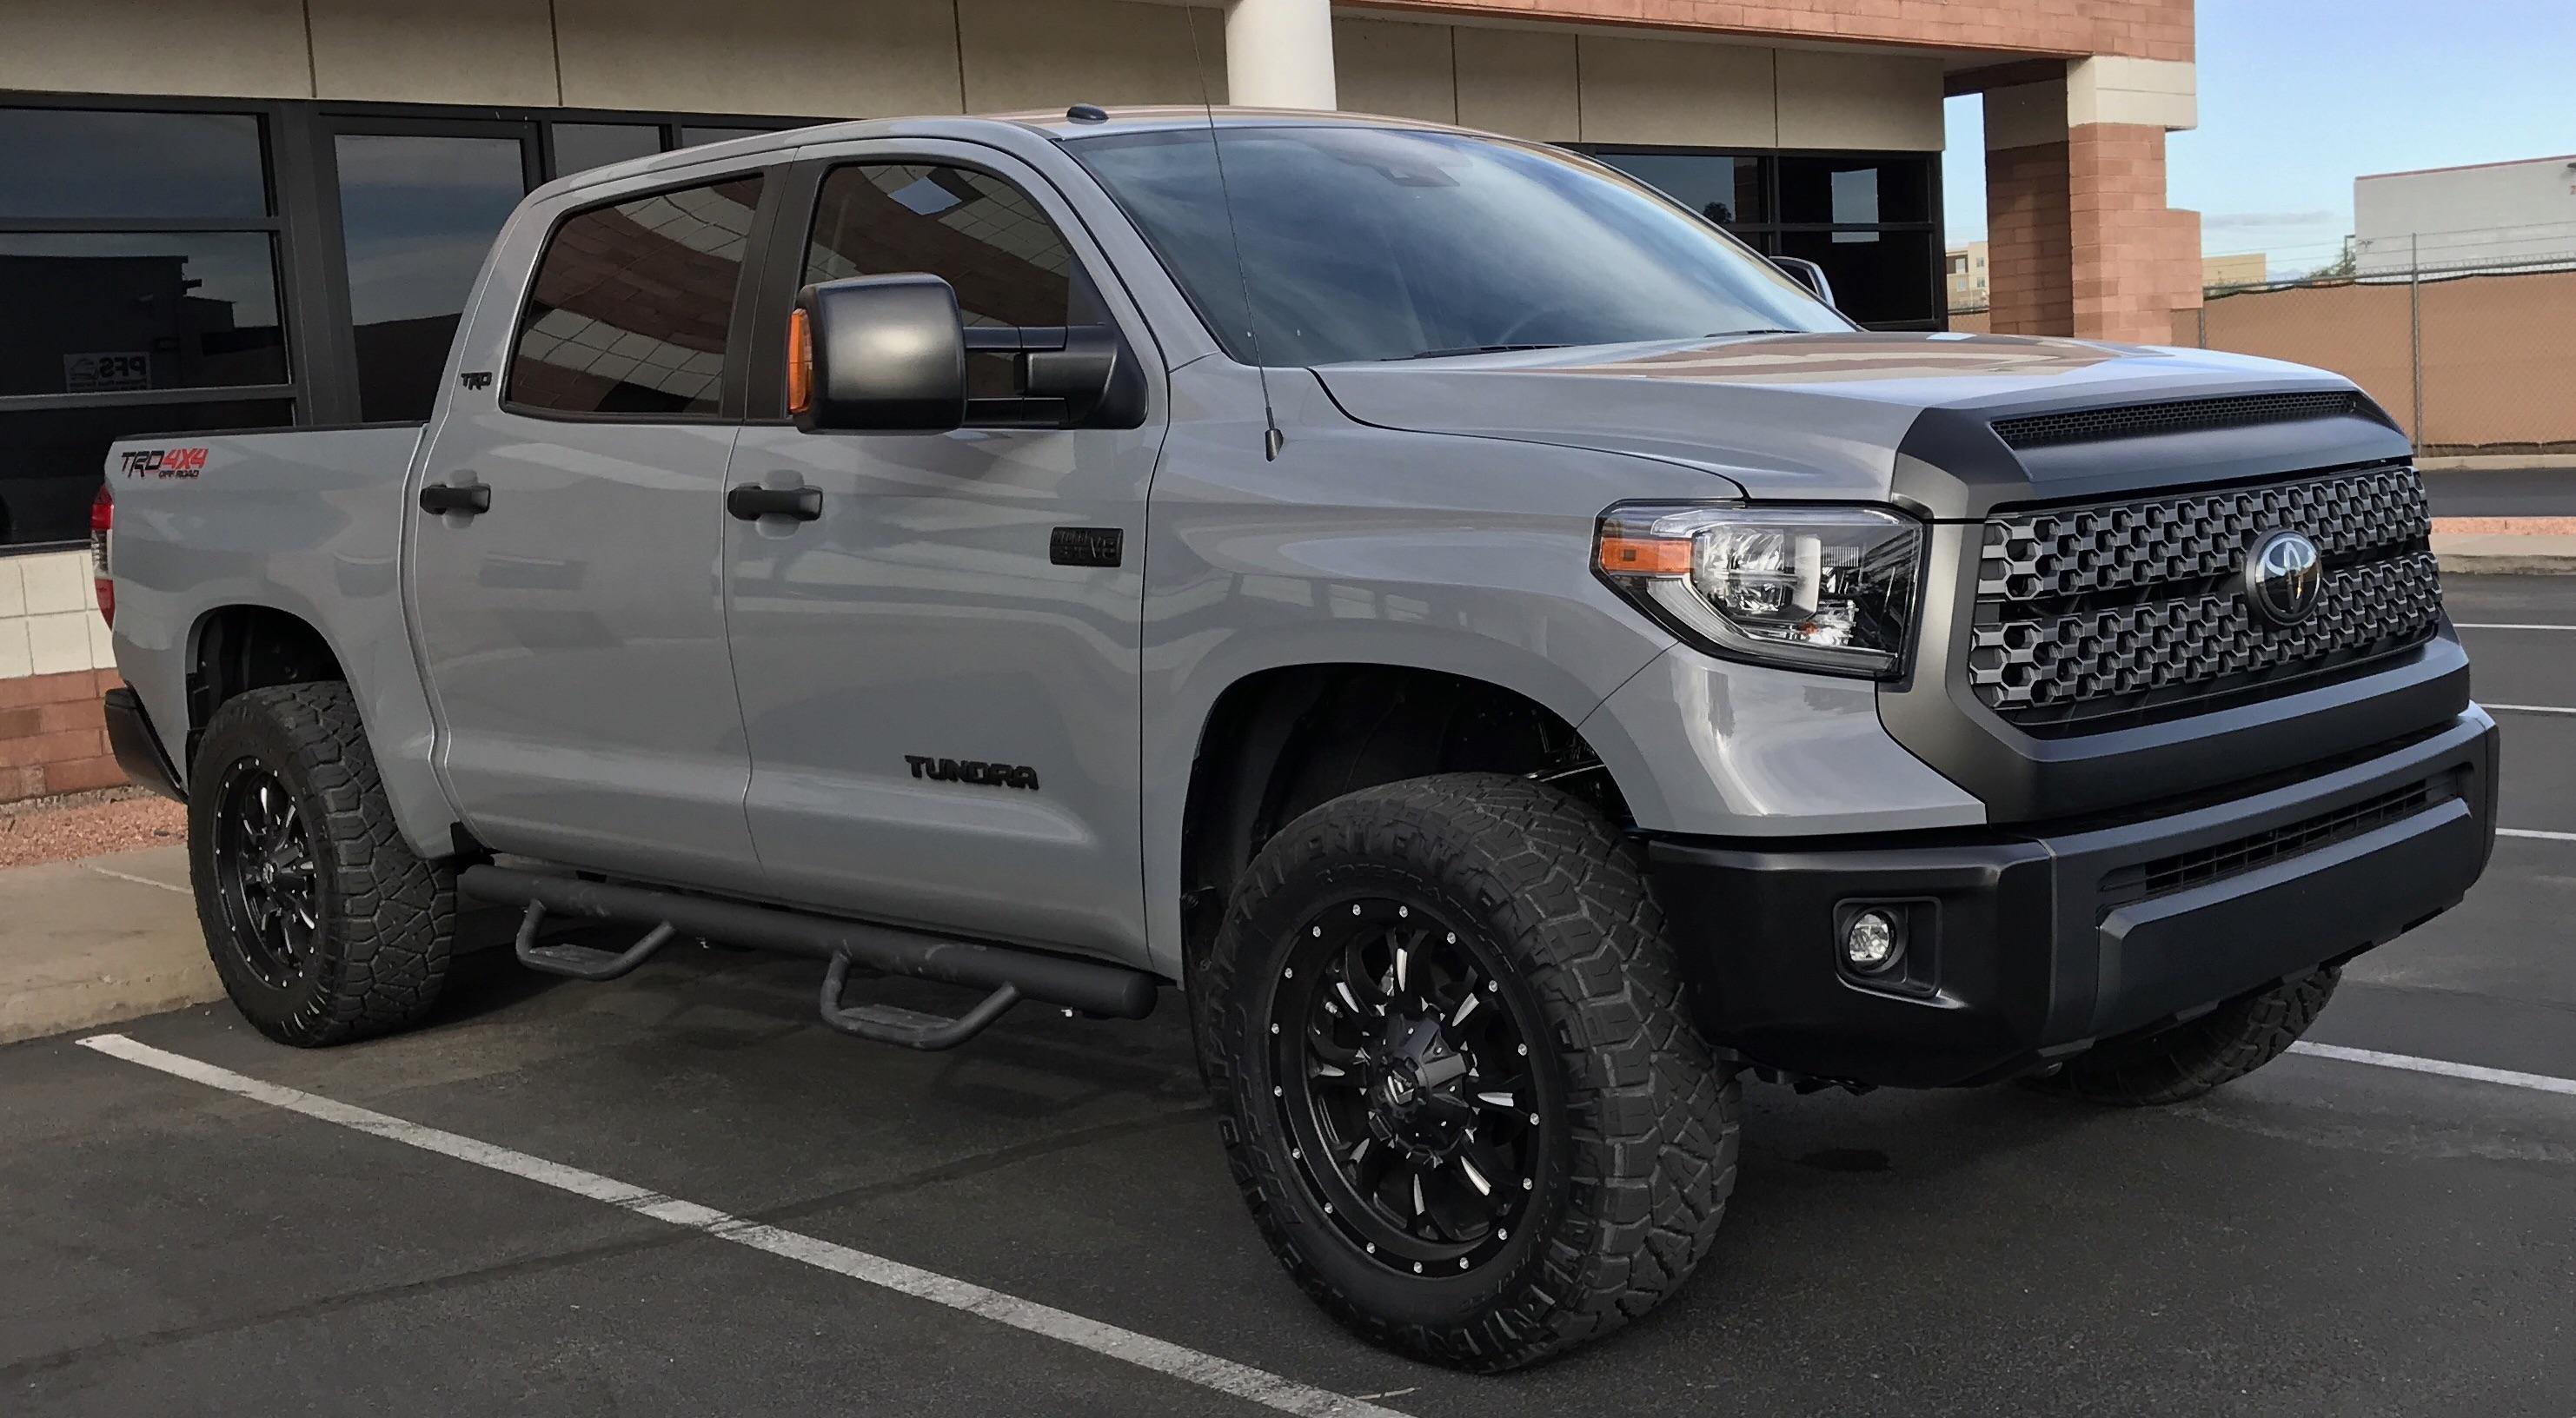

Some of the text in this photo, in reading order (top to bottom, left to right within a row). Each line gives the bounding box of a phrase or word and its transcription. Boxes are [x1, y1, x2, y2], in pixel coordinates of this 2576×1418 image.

[461, 371, 493, 391] TRD
[122, 450, 165, 479] TRD
[158, 469, 200, 480] OFF ROAD
[904, 754, 1039, 791] TUNDRA
